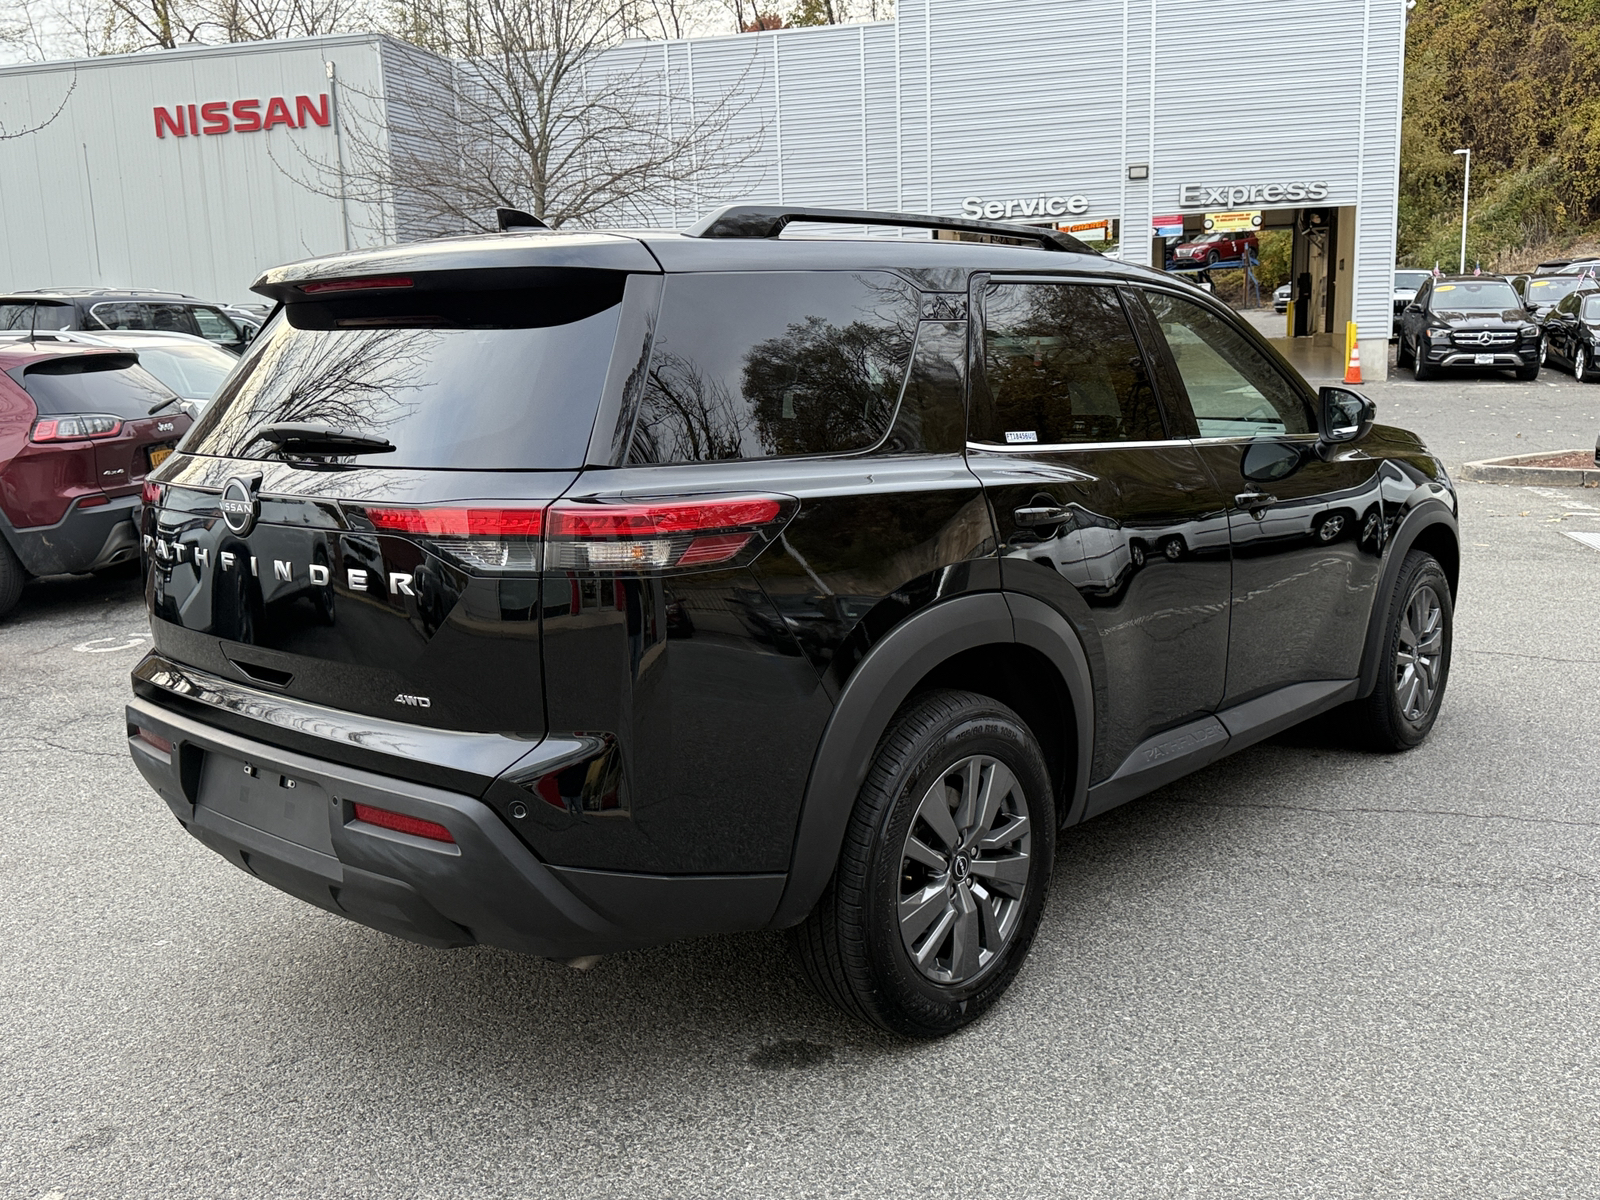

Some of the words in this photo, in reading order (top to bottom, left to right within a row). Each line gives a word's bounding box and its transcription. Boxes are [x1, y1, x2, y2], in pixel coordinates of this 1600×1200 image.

[153, 94, 331, 138] NISSAN
[961, 193, 1089, 220] Service
[1179, 180, 1328, 210] Express
[158, 422, 174, 431] Jeep
[144, 534, 414, 596] PATHFINDER
[394, 693, 431, 708] 4WD
[1143, 724, 1223, 762] PATHFINDER
